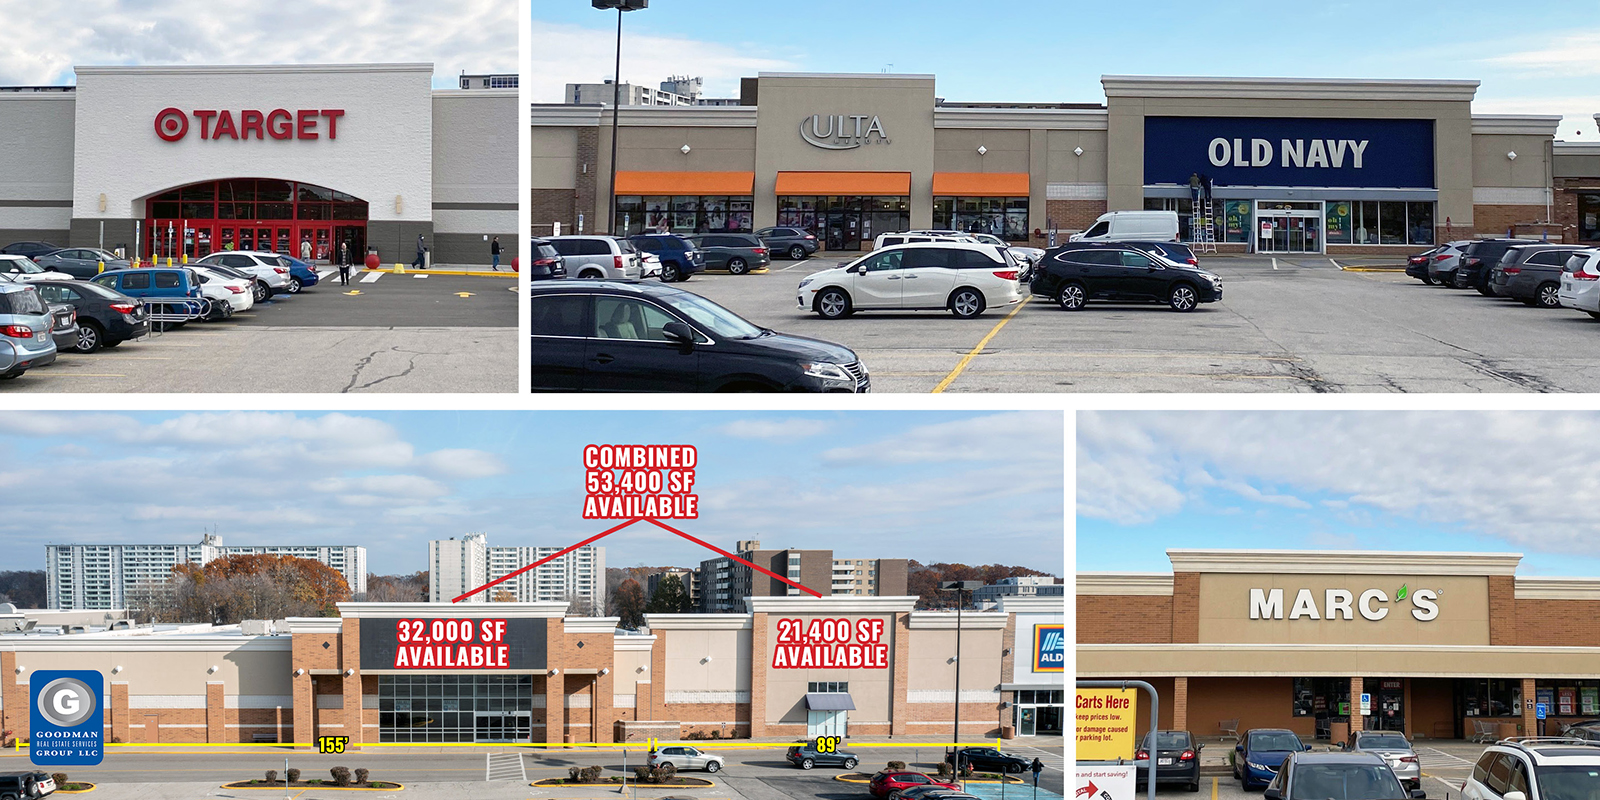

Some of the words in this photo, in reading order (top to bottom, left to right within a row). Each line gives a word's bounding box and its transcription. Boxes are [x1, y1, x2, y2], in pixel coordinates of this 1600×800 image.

[193, 108, 345, 140] TARGET
[812, 114, 887, 139] ULTA
[1208, 137, 1274, 167] OLD
[1281, 138, 1369, 169] NAVY
[1250, 584, 1440, 622] MARC'S
[1076, 695, 1103, 709] Carts
[1105, 695, 1130, 709] Here
[1080, 734, 1102, 742] parking
[1083, 726, 1106, 734] damage
